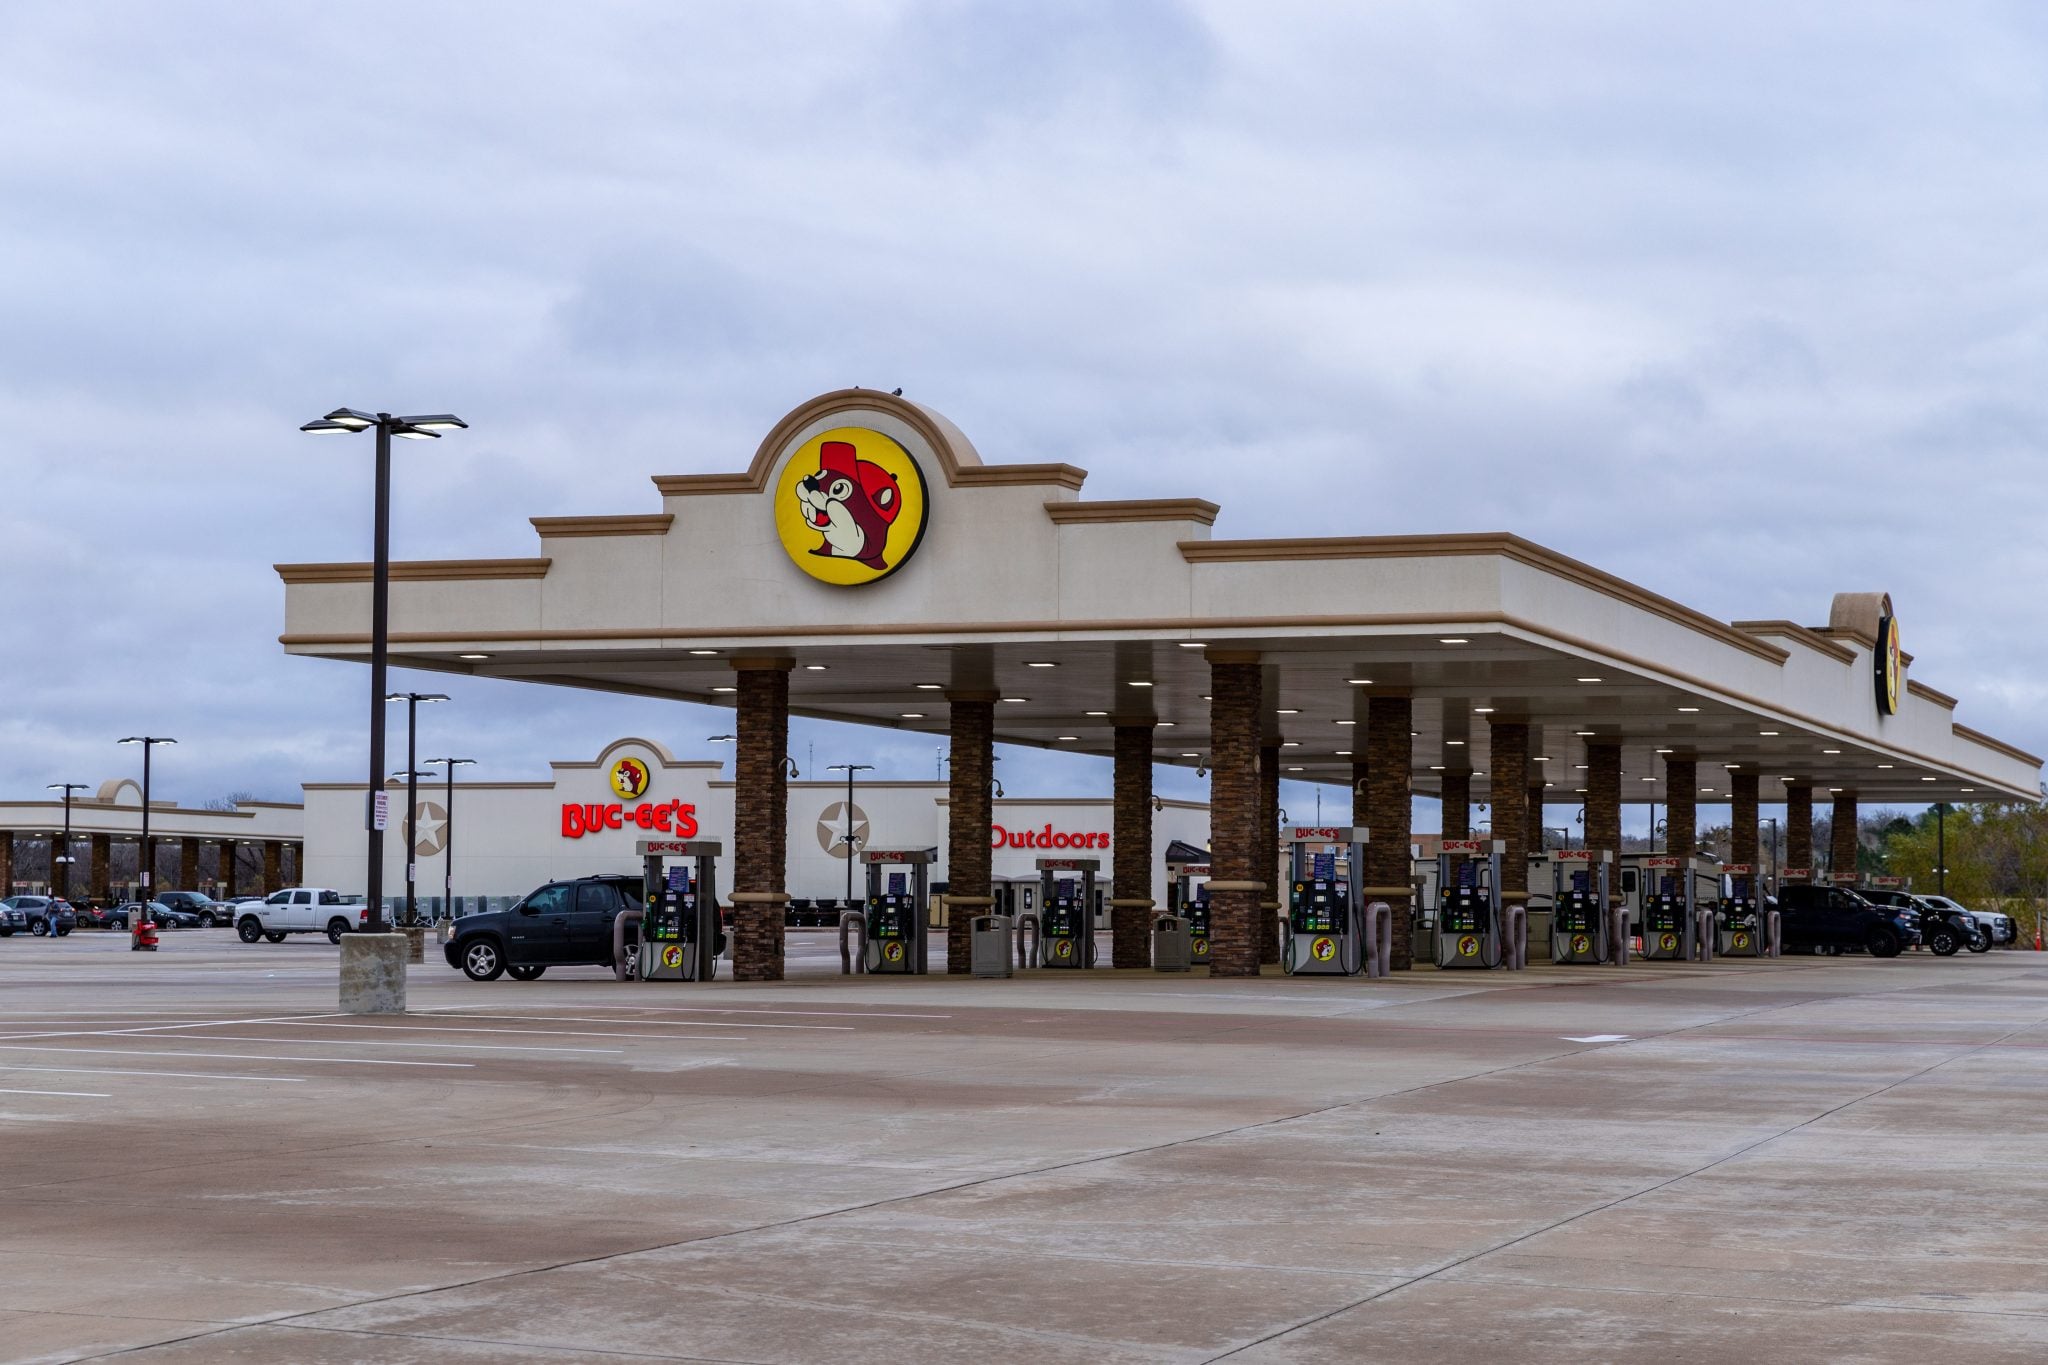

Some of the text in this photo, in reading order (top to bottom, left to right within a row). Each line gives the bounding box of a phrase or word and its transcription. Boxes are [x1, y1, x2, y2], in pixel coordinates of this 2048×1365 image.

[561, 799, 698, 838] BUC-EE'S
[991, 823, 1111, 848] Outdoors
[1295, 827, 1340, 840] BUC-EE'S
[648, 842, 687, 855] BUC-EE'S
[1442, 840, 1482, 852] BUC-EE'S
